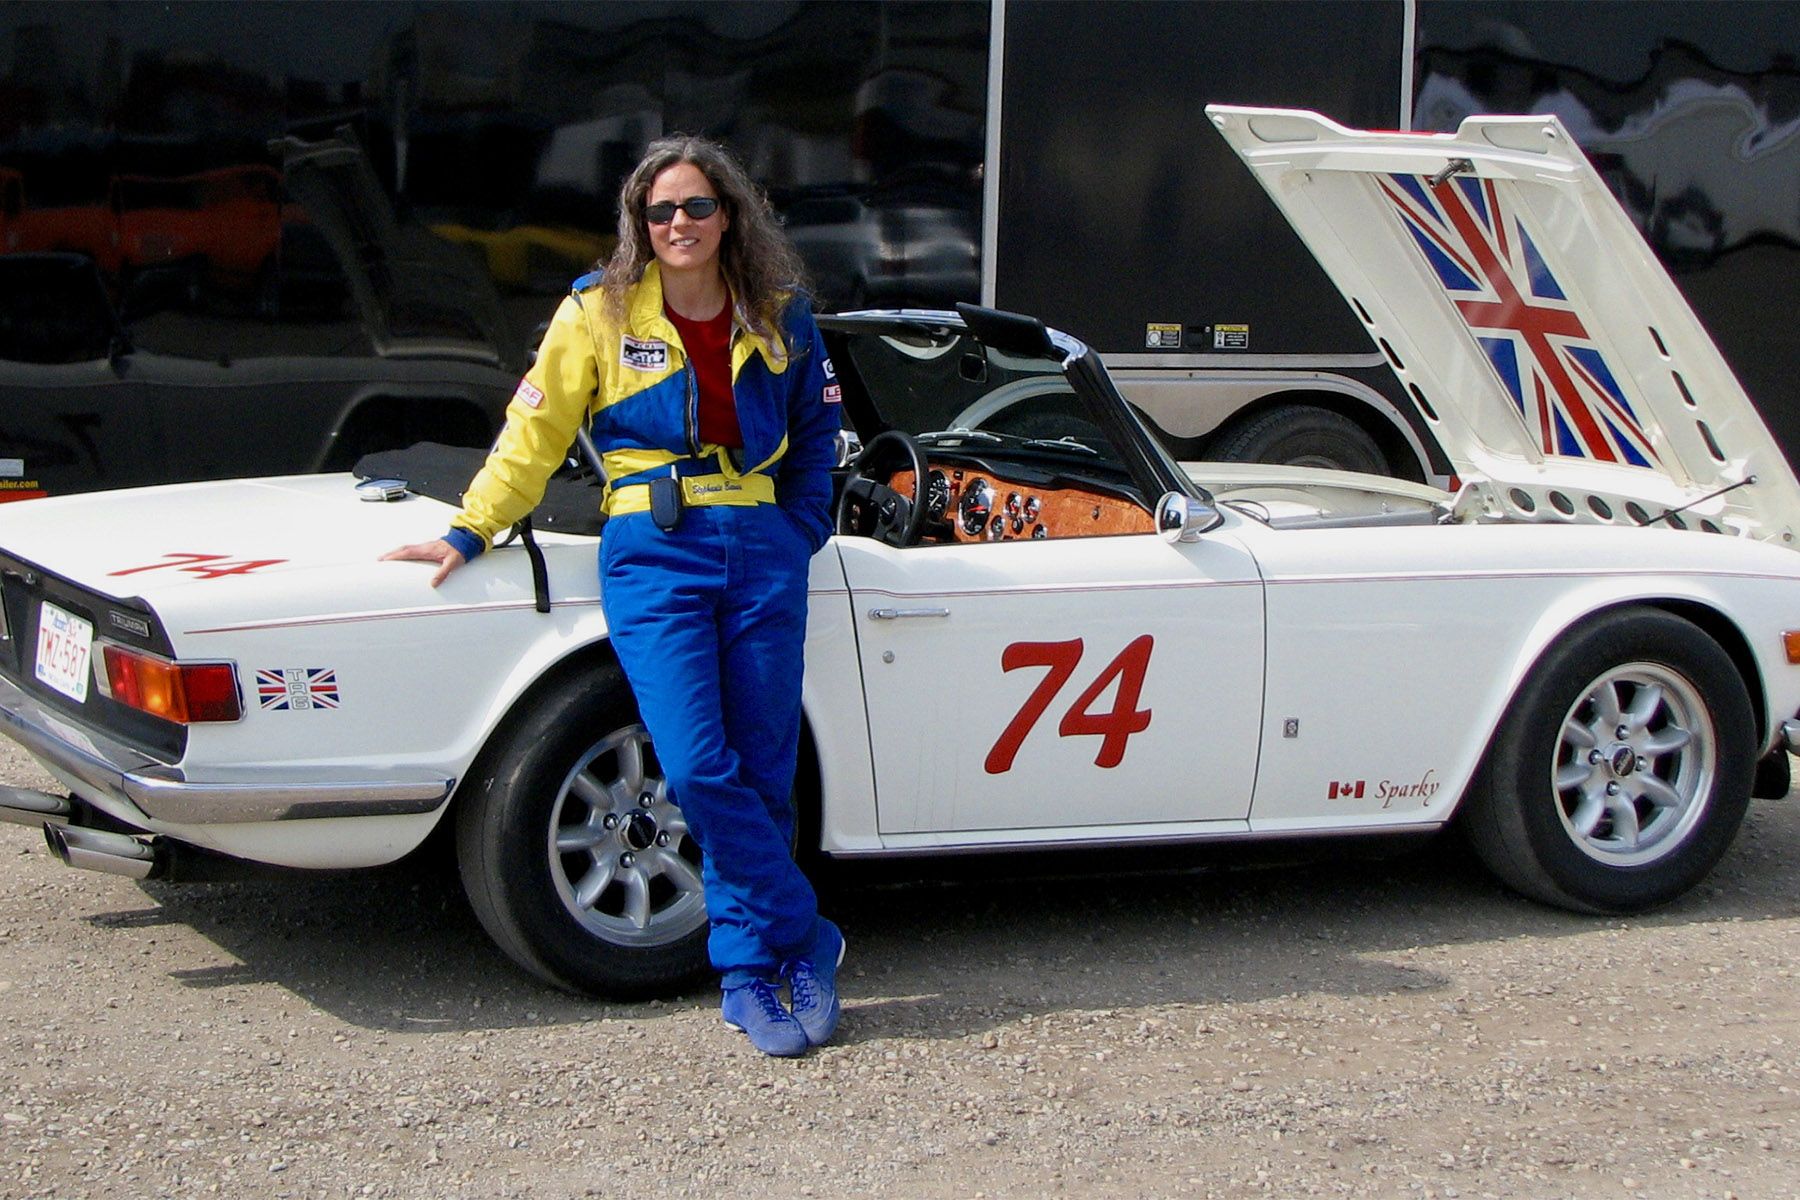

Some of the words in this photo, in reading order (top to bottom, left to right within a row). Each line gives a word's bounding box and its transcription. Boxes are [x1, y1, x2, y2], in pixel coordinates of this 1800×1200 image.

[105, 553, 290, 579] 74
[985, 634, 1154, 774] 74
[1374, 769, 1440, 808] Sparky
